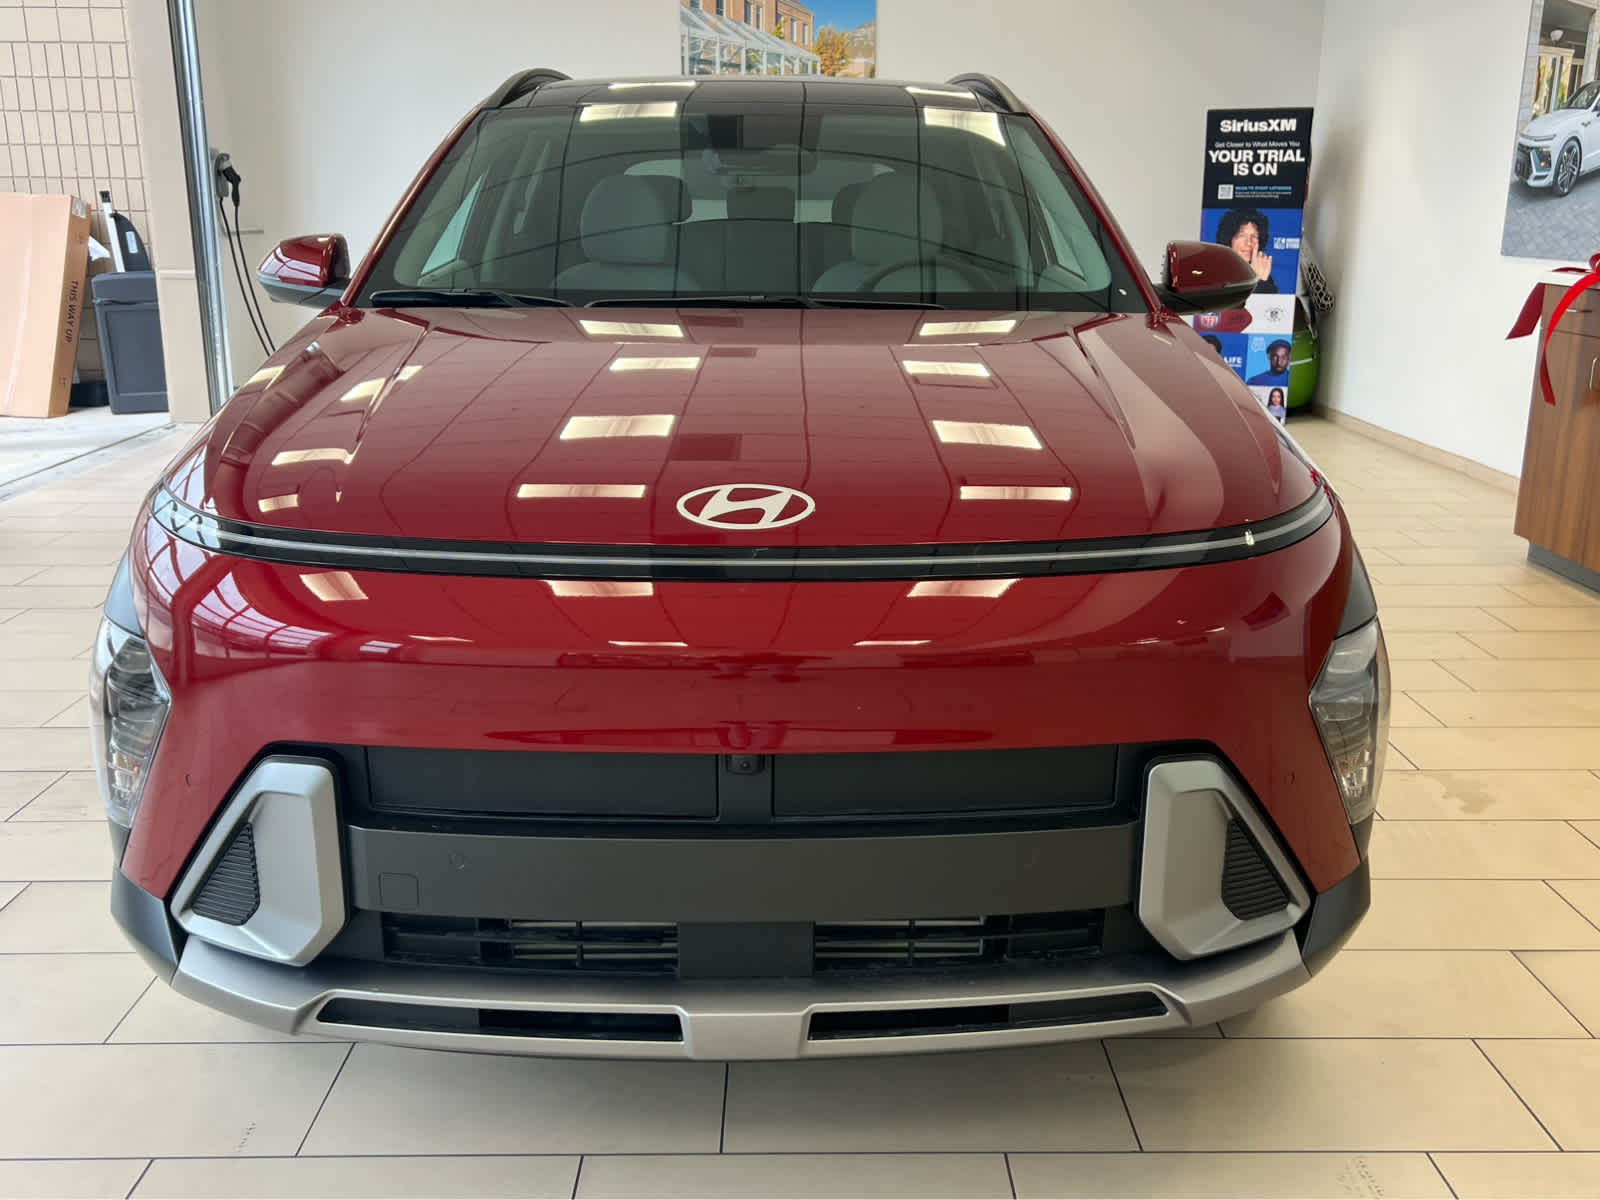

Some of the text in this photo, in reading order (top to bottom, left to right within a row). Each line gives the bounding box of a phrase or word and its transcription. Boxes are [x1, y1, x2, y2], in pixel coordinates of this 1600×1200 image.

[1220, 118, 1297, 132] SiriusXM
[1208, 149, 1305, 163] YOUR TRIAL
[1233, 162, 1278, 176] IS ON
[65, 280, 78, 343] THIS WAY UP
